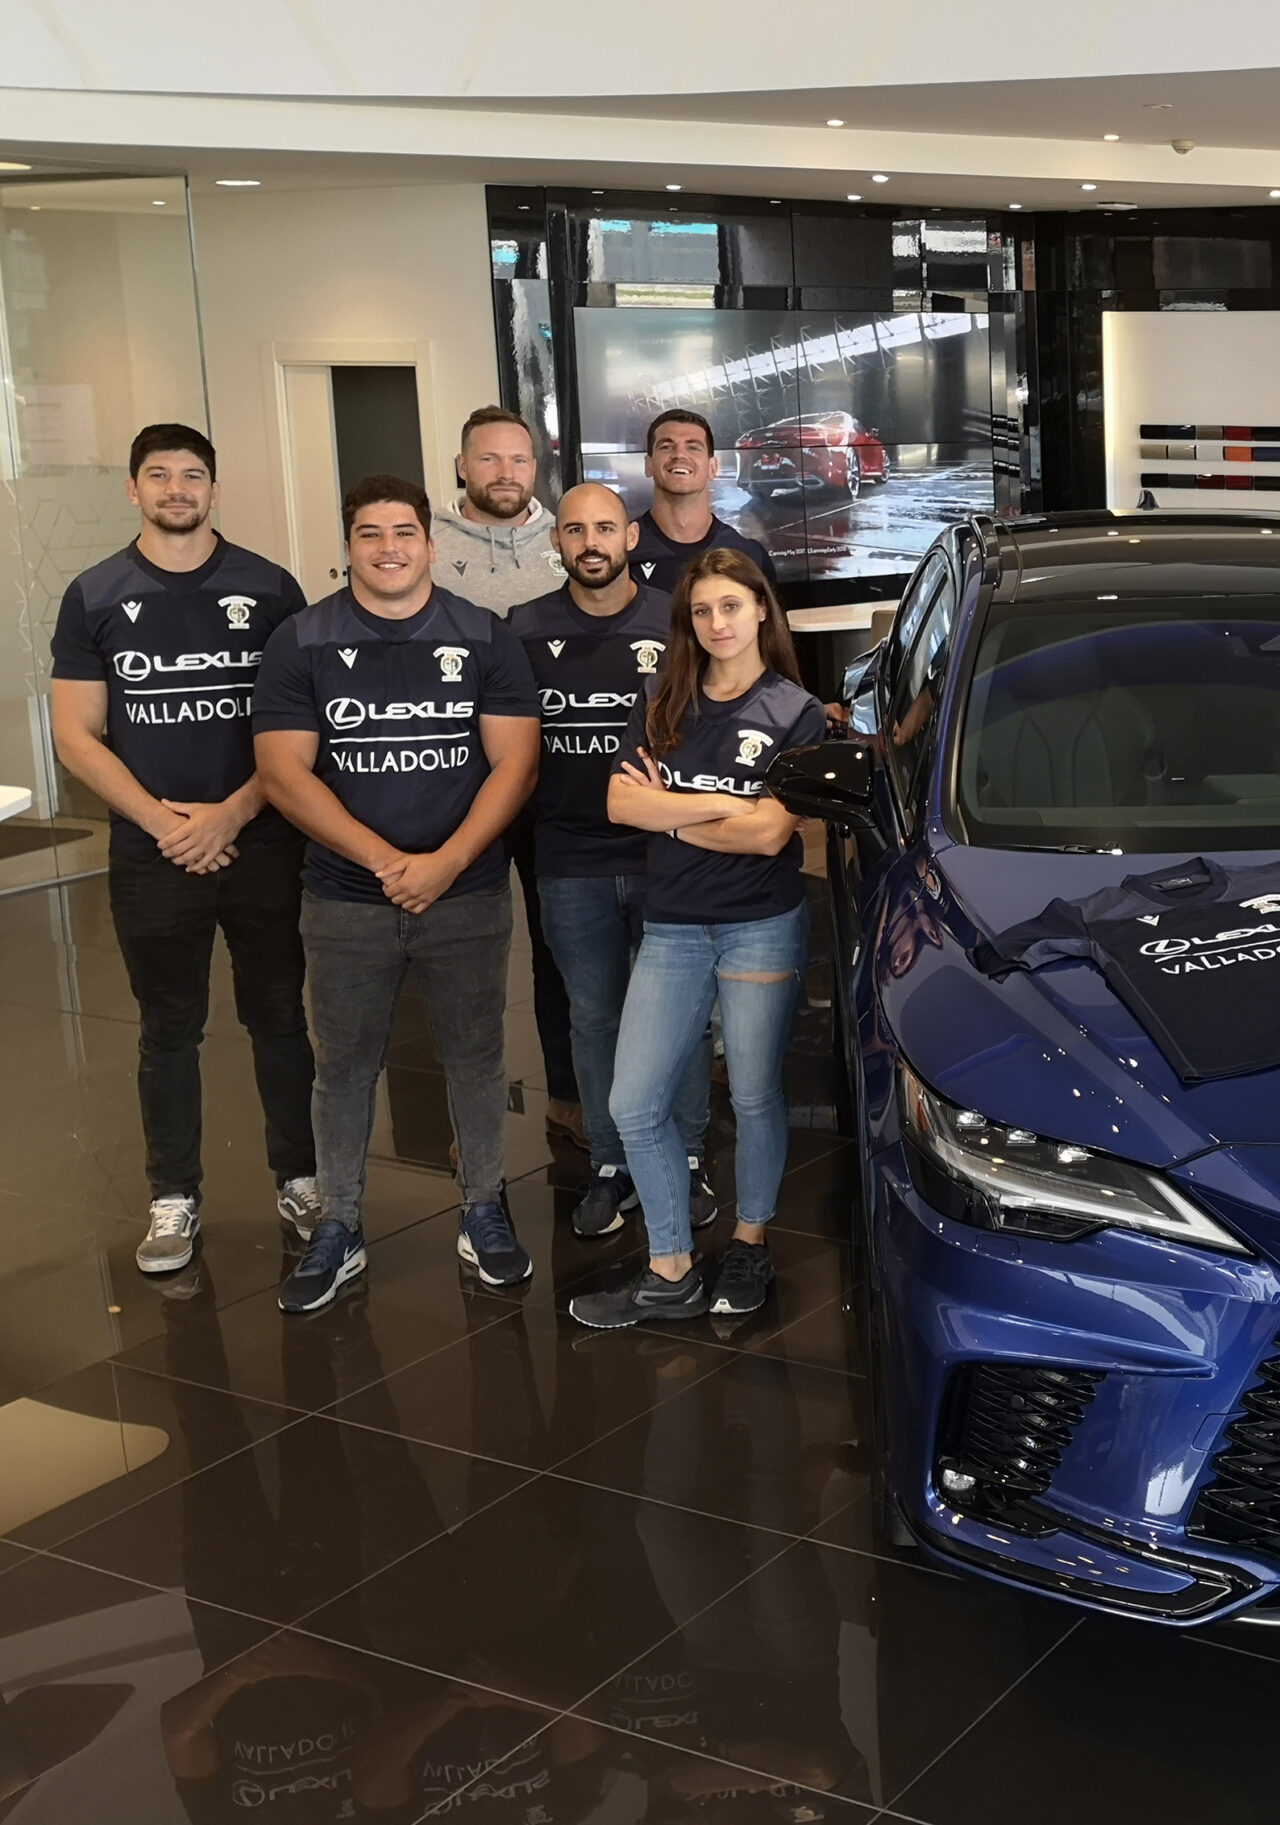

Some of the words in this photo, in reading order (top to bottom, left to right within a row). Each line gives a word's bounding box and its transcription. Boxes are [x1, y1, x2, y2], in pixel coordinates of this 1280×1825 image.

[153, 651, 263, 672] LEXUS
[125, 696, 251, 724] VALLADOLI
[568, 692, 638, 708] LEX
[368, 701, 474, 720] LEXUS
[544, 734, 620, 754] VALLAD
[331, 746, 470, 773] VALLADOLID
